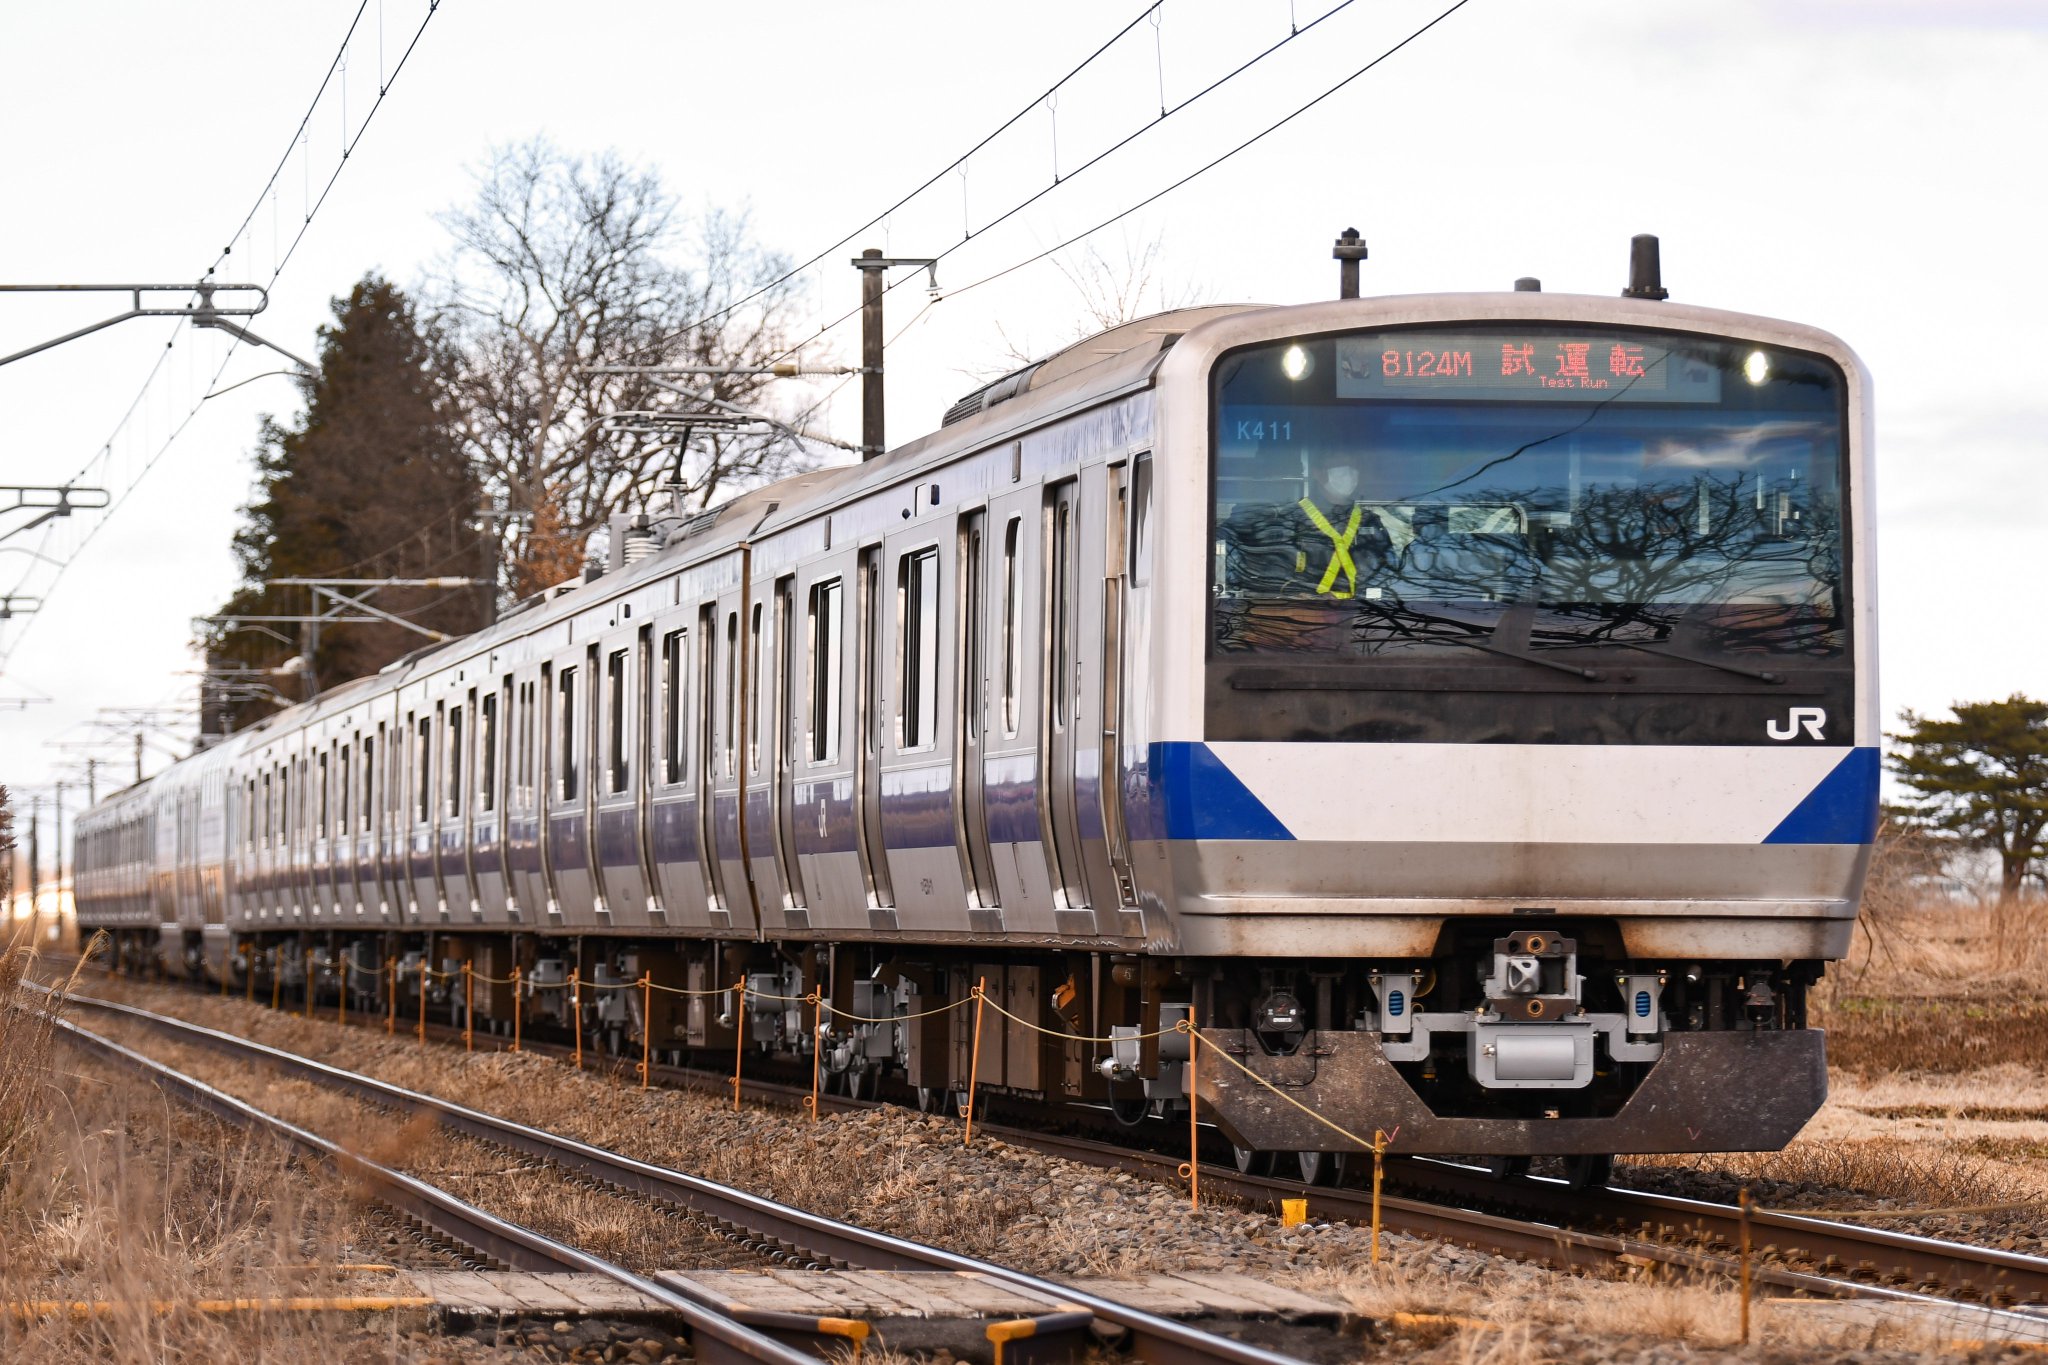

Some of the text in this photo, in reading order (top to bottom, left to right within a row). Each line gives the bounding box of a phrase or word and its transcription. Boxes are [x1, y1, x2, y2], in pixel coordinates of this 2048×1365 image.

[1382, 350, 1473, 377] 8124M
[1501, 343, 1646, 377] 試運転
[1539, 376, 1608, 389] Test Run
[1237, 421, 1291, 440] K411
[1766, 707, 1826, 740] JR
